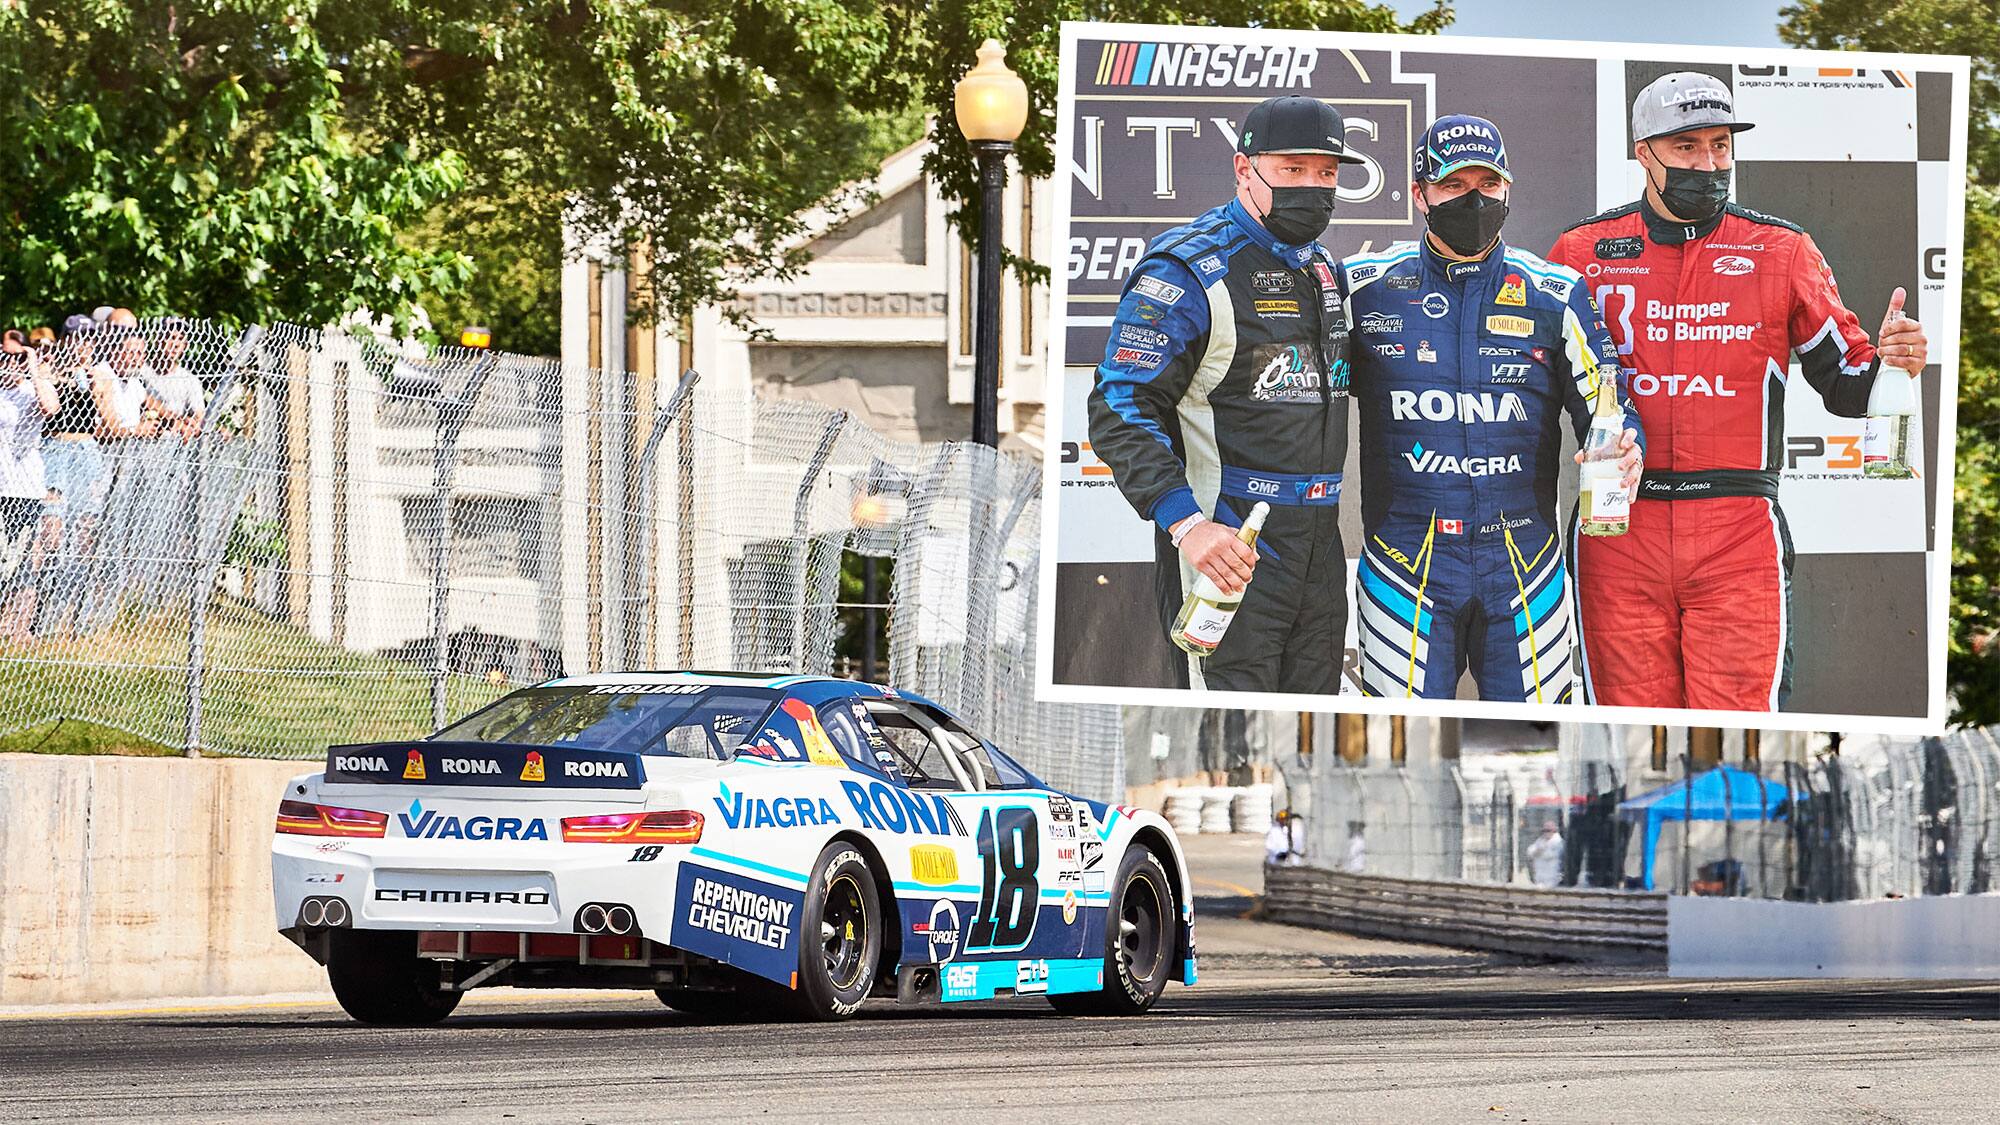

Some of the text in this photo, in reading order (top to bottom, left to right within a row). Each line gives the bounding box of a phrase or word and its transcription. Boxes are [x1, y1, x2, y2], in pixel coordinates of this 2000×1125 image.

[1149, 43, 1319, 88] NASCAR
[1437, 124, 1495, 143] RONA
[1441, 143, 1496, 157] VIAGRA
[1596, 242, 1642, 251] PINTY'S
[1198, 256, 1225, 273] OMP
[1455, 265, 1481, 276] RONA
[1602, 265, 1650, 274] Permatex
[1713, 257, 1753, 273] Gates
[1253, 277, 1293, 286] PINTY'S
[1351, 265, 1378, 283] OMP
[1540, 279, 1566, 294] OMP
[1646, 300, 1731, 323] Bumper
[1361, 319, 1404, 327] 440 LAVAL
[1362, 325, 1404, 334] CHEVROLET
[1646, 321, 1756, 344] to Bumper
[1114, 348, 1162, 364] AMSOIL
[1478, 347, 1522, 356] FAST
[1491, 363, 1532, 377] VTT
[1621, 367, 1737, 397] TOTAL
[1389, 389, 1529, 424] RONA
[1402, 444, 1523, 477] VIAGRA
[1247, 478, 1280, 496] OMP
[1645, 480, 1712, 491] Kevin Lacroix
[1479, 523, 1501, 533] ALEX
[588, 684, 710, 695] TAGLIANI
[335, 756, 390, 773] RONA
[442, 758, 502, 774] RONA
[564, 761, 629, 777] RONA
[713, 785, 842, 829] VIAGRA
[839, 779, 968, 838] RONA
[397, 803, 549, 841] VIAGRA
[627, 846, 664, 862] 18
[824, 850, 867, 884] GENERAL
[1059, 870, 1081, 881] PFC
[963, 805, 1040, 955] 18
[375, 888, 550, 905] CAMARO
[692, 877, 794, 927] REPENTIGNY
[688, 903, 791, 950] CHEVROLET
[928, 929, 960, 945] TORQUE
[948, 965, 980, 988] FAST
[1113, 935, 1145, 1006] GENERAL
